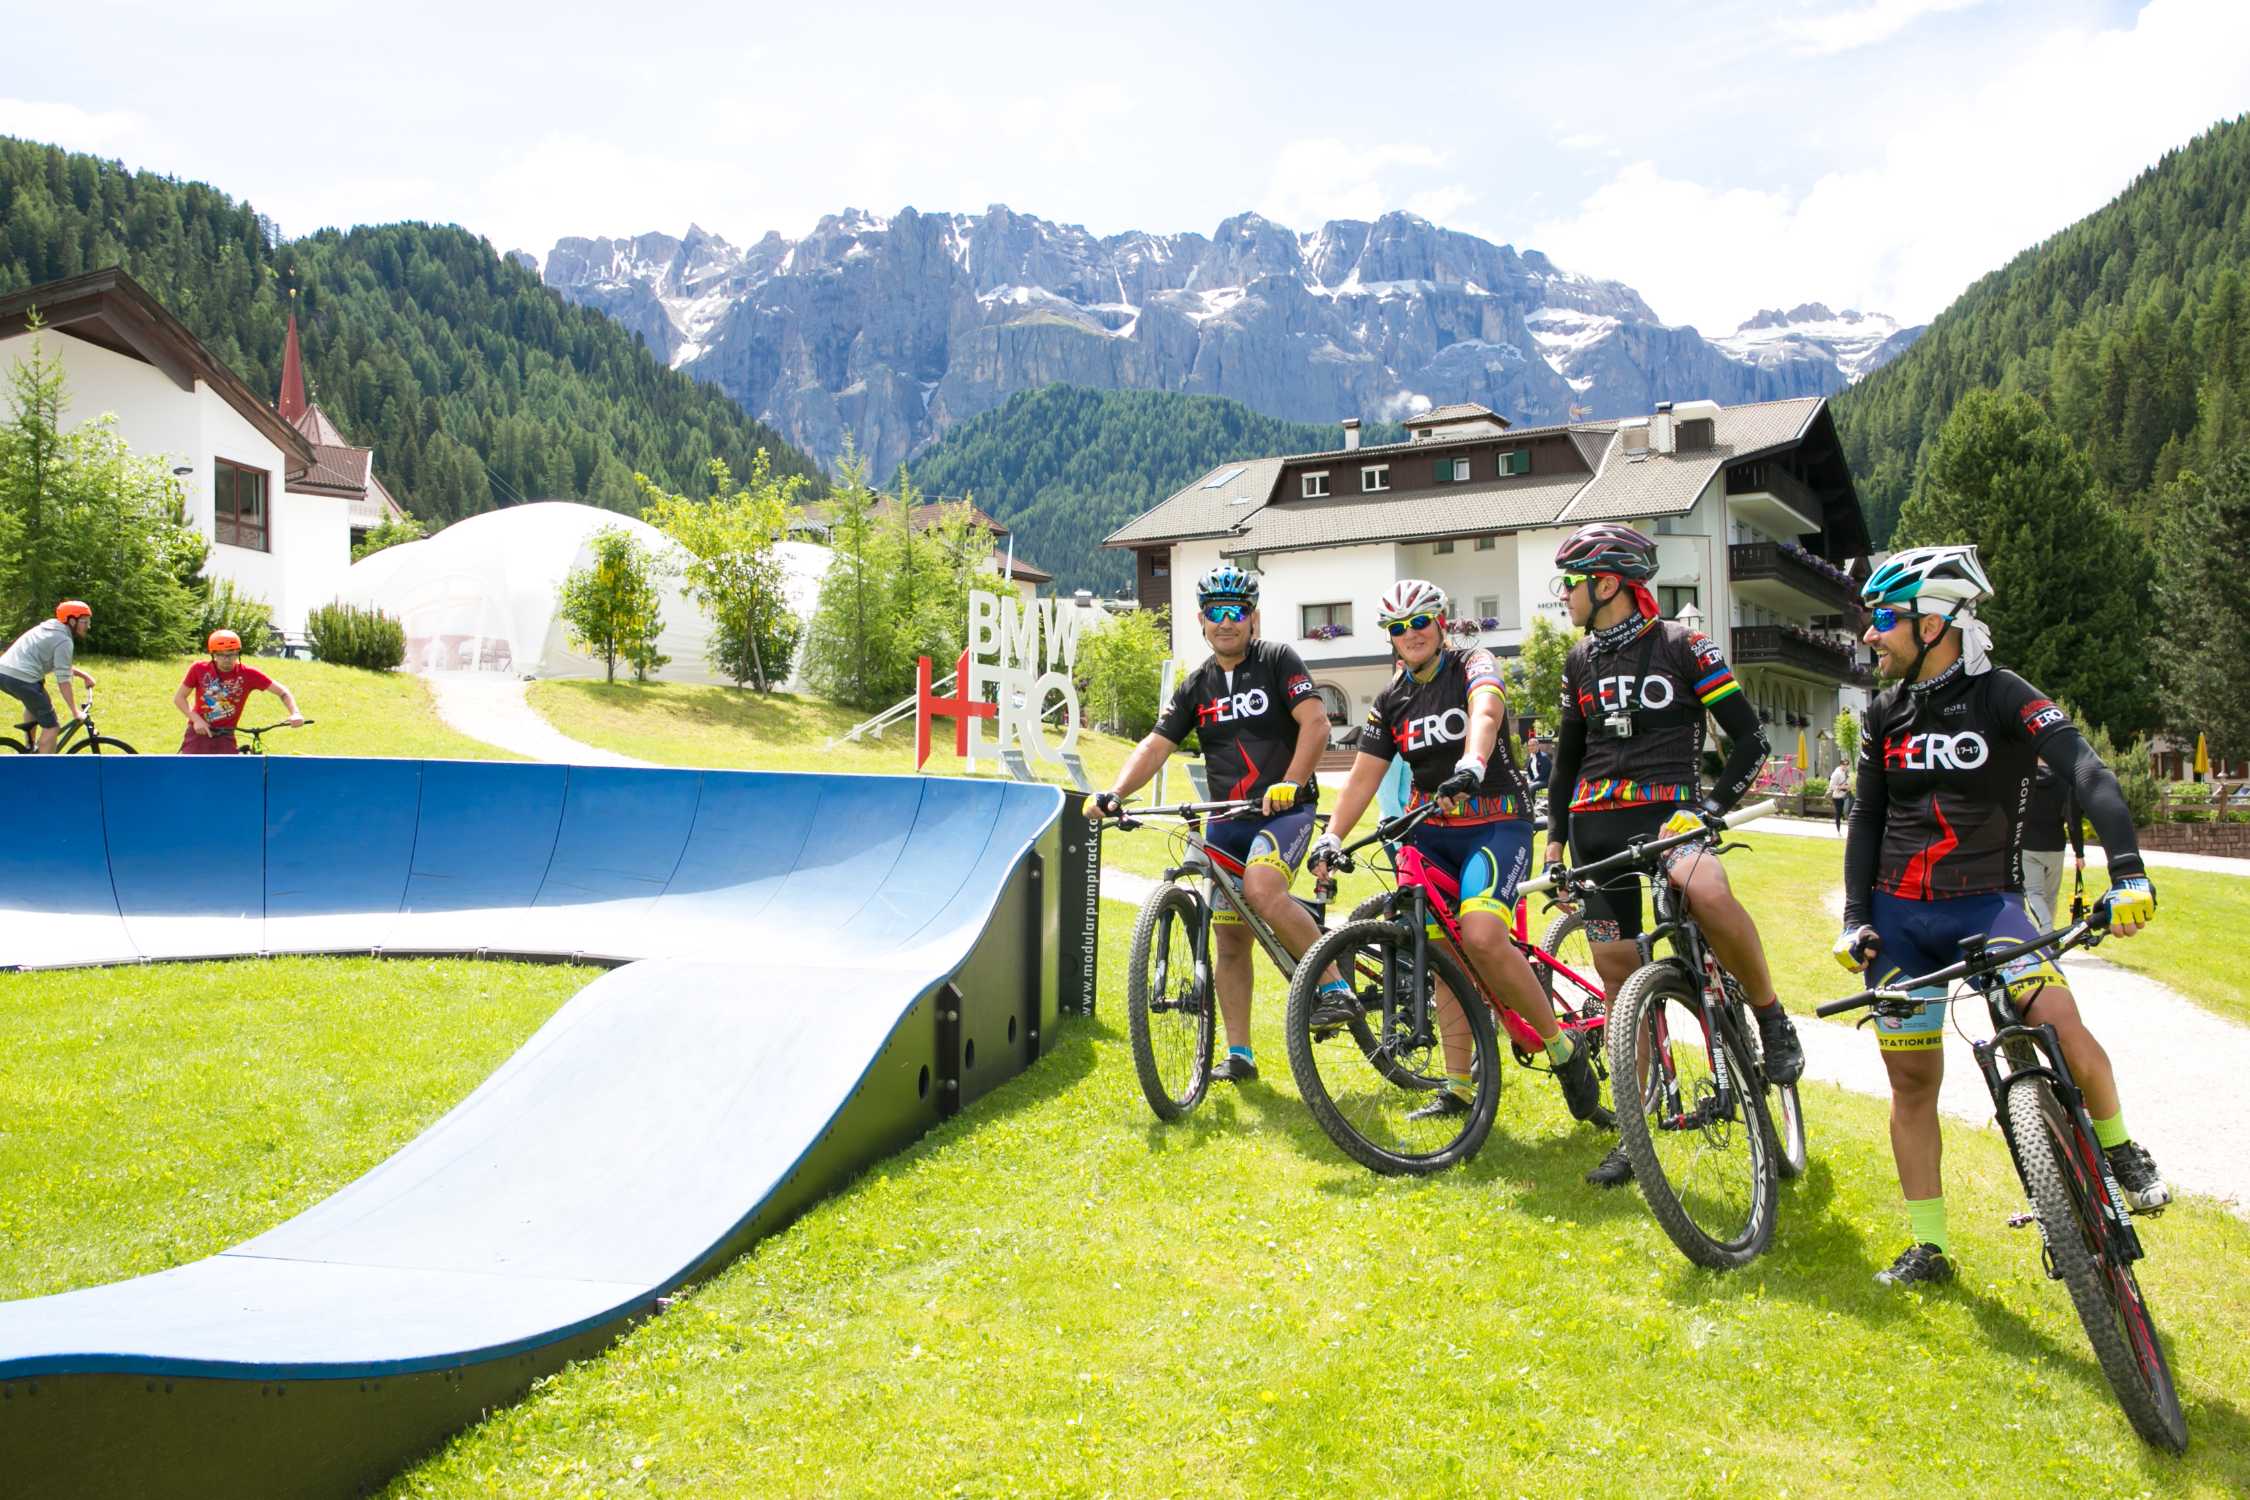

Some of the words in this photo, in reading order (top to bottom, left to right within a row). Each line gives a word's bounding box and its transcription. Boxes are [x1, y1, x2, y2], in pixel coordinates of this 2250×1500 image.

[969, 589, 1080, 667] BMW
[916, 645, 1081, 771] HERO
[1196, 688, 1269, 727] HERO
[2026, 709, 2064, 736] HERO
[1392, 707, 1469, 752] HERO
[1883, 730, 1989, 769] HERO
[2019, 777, 2030, 815] GORE
[1081, 817, 1101, 1017] www.modularpumptrack.co
[1712, 1048, 1730, 1090] ROCKSHOX
[2104, 1175, 2133, 1227] ROCKSHOX
